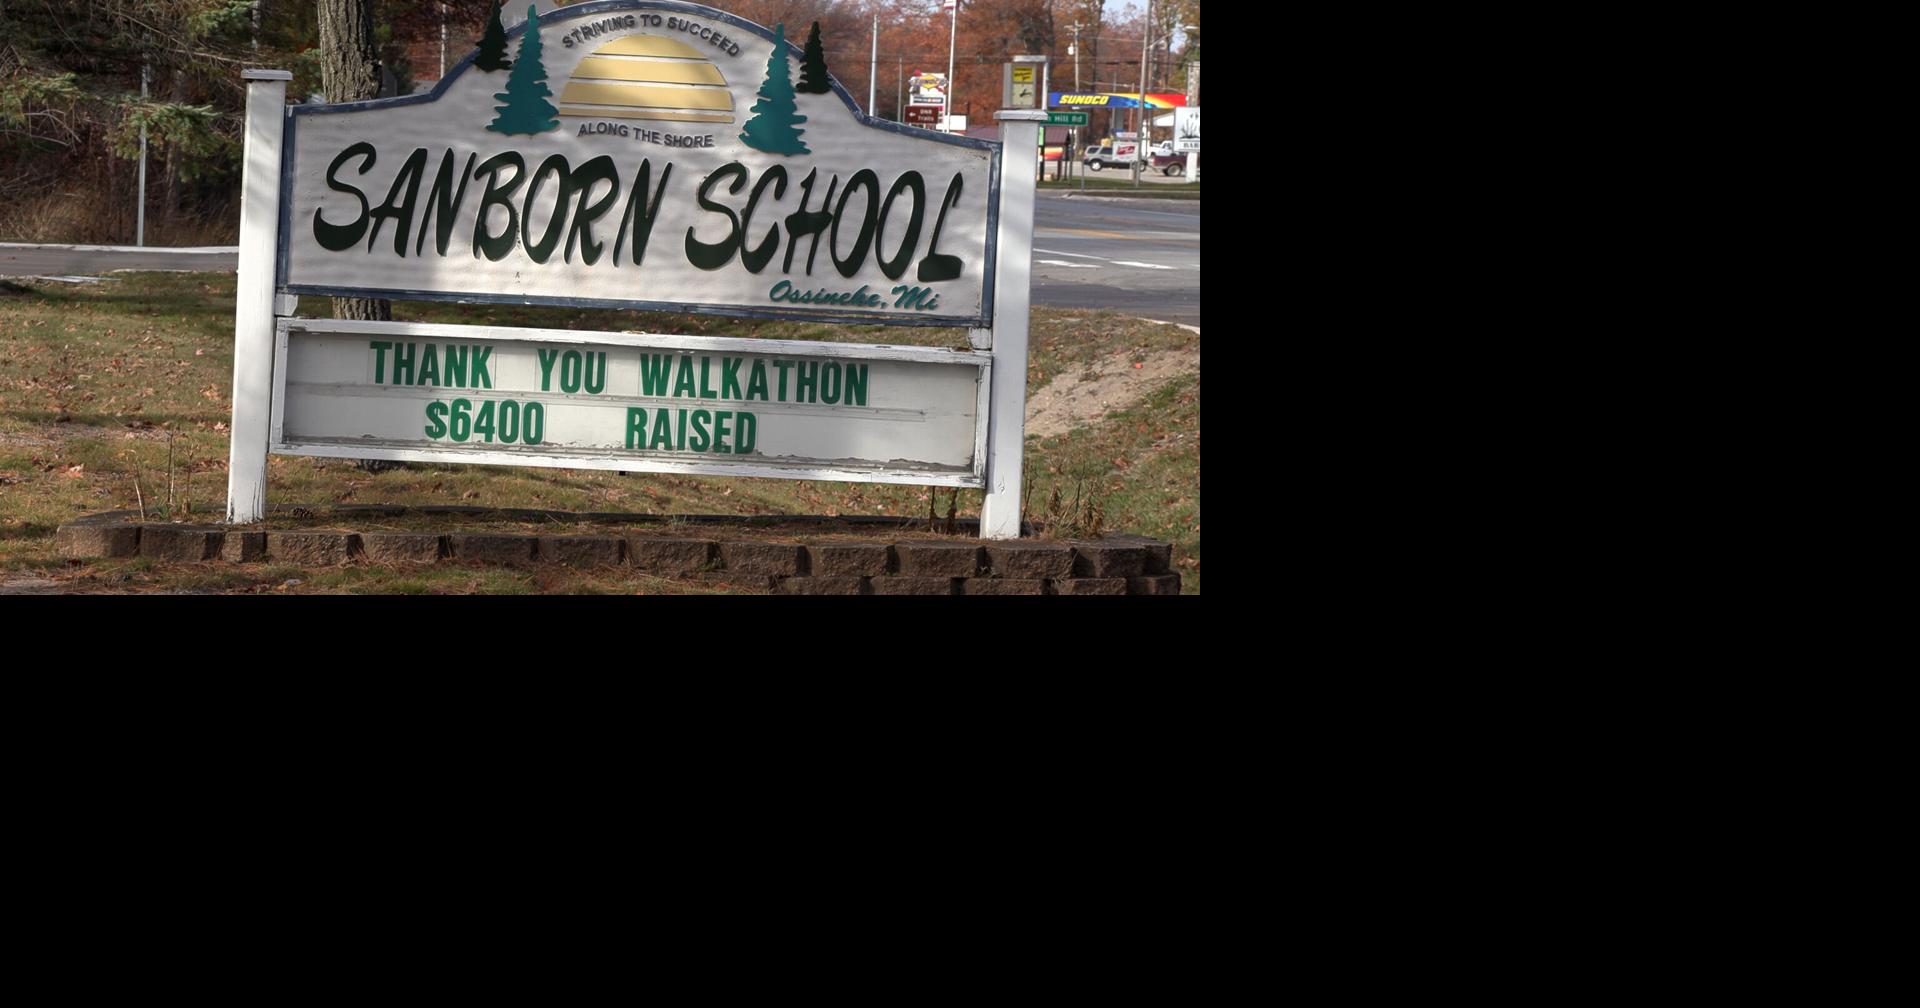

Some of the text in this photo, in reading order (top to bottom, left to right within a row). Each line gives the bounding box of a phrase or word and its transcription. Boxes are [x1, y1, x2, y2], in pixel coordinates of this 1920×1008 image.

[561, 14, 741, 58] STRIVING TO SUCCEED
[1059, 94, 1109, 105] SUNOCO
[577, 122, 714, 148] ALONG THE SHORE
[313, 141, 965, 283] SANBORN SCHOOL
[769, 279, 941, 311] Ossineke, Mi
[370, 340, 869, 407] THANK YOU WALKATHON
[424, 399, 757, 455] $6400 RAISED
